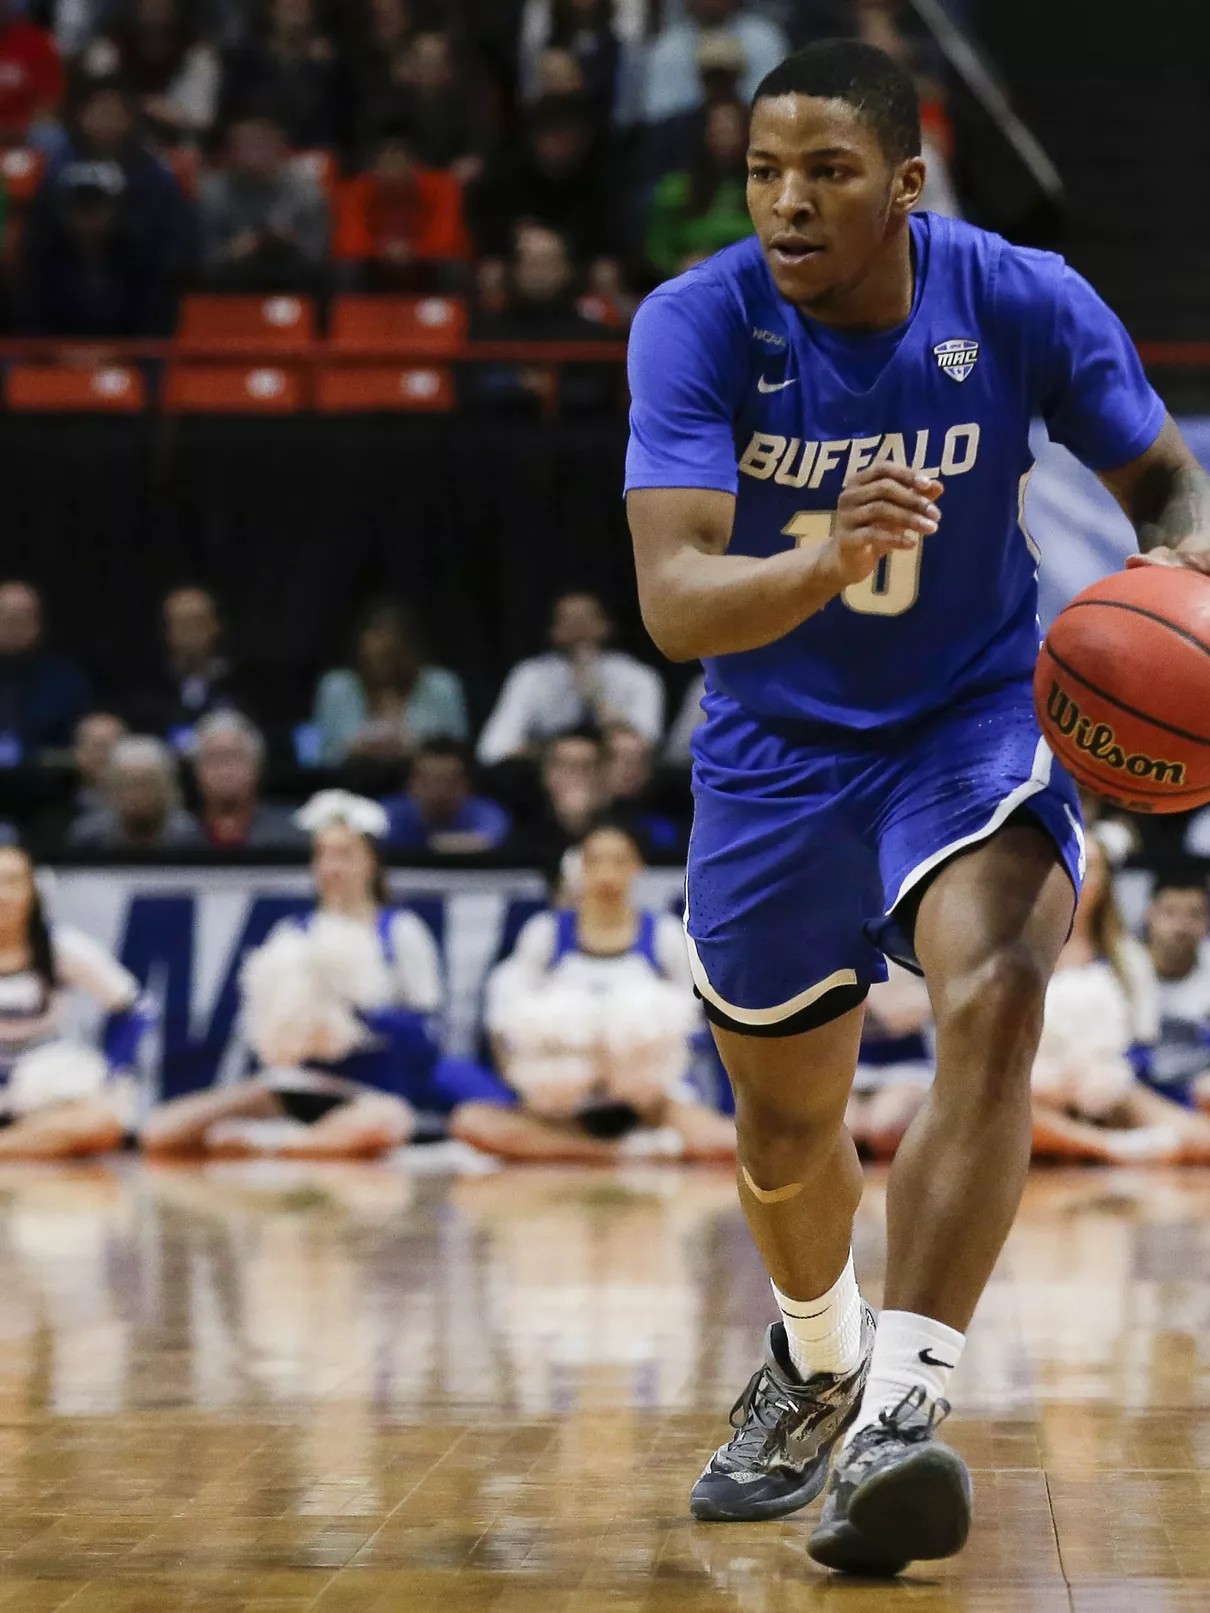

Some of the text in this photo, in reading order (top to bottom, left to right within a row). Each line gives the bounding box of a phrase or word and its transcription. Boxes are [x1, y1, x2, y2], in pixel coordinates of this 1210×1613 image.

[937, 349, 978, 368] MAC
[738, 422, 980, 489] BUFFALO
[1046, 678, 1187, 786] Wilson
